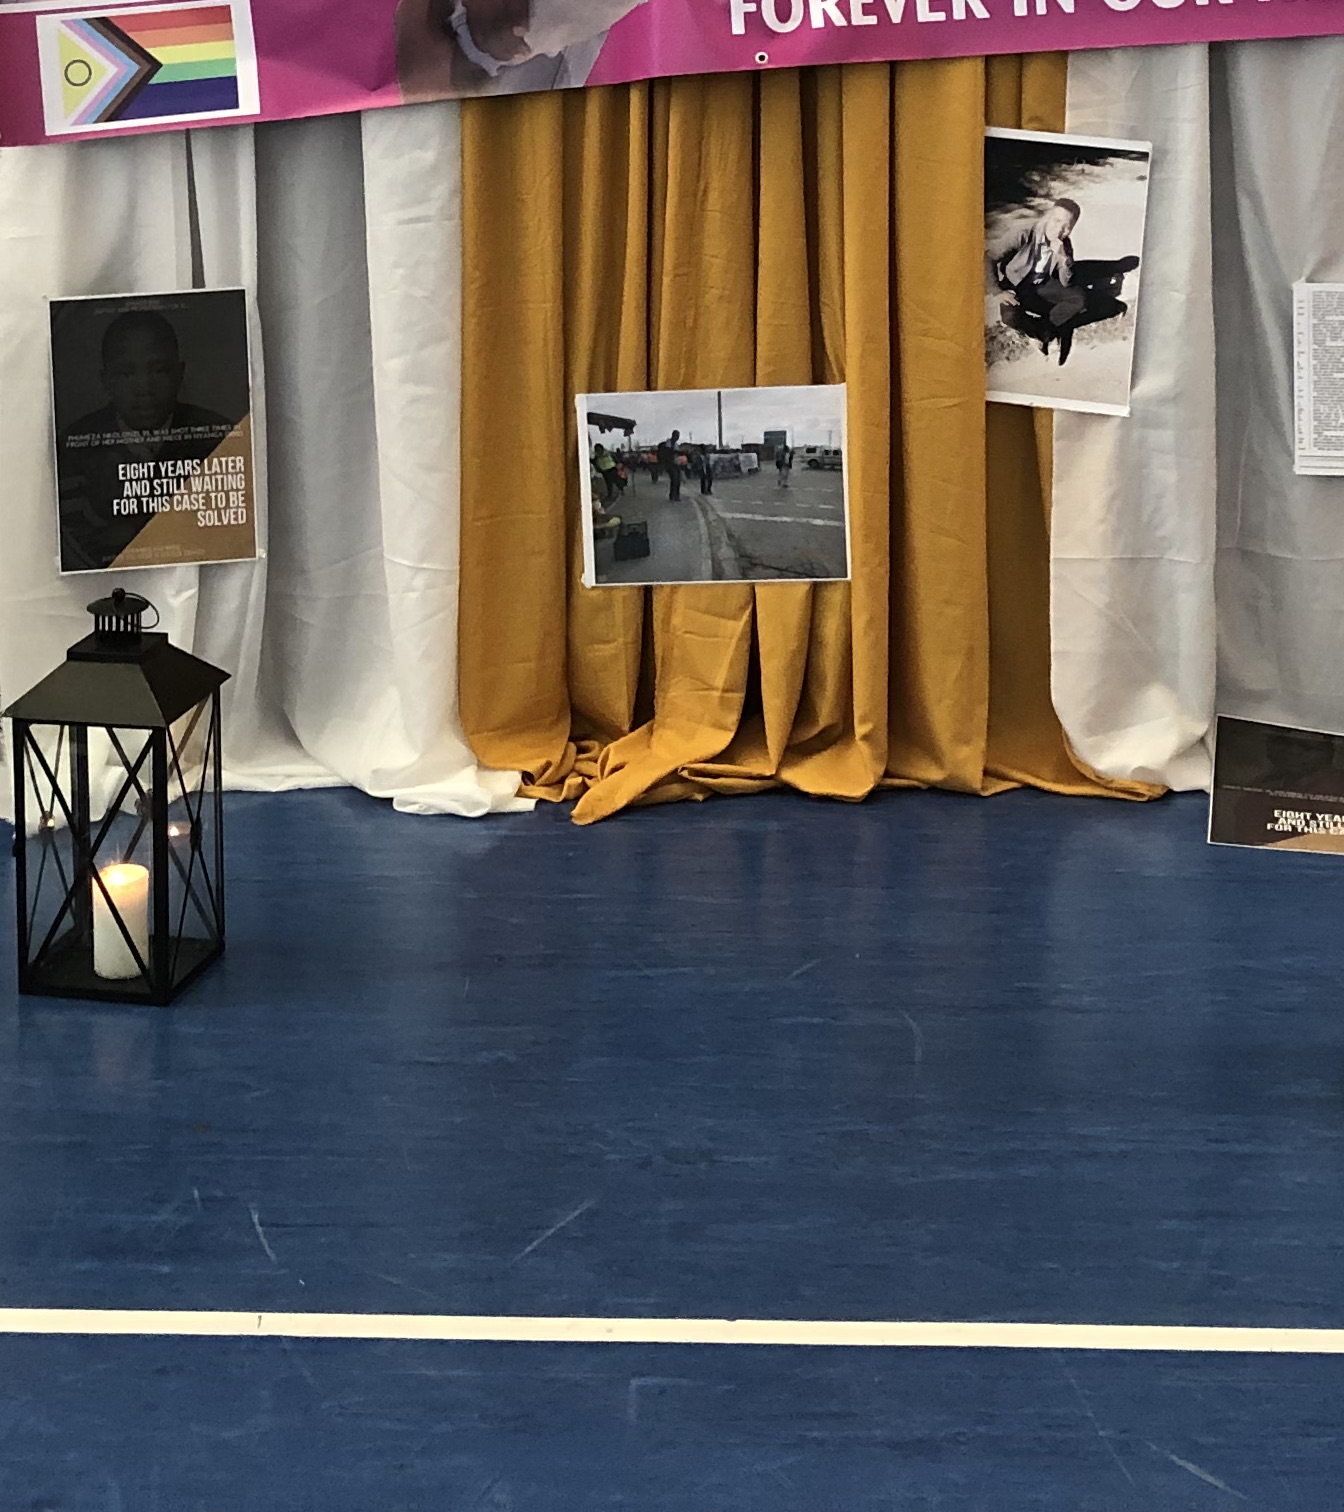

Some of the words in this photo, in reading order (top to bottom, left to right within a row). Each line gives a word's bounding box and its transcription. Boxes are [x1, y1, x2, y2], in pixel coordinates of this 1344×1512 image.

[118, 462, 156, 480] EIGHT
[159, 459, 201, 477] YEARS
[204, 456, 244, 474] LATER
[123, 480, 150, 498] AND
[153, 477, 186, 496] STILL
[190, 473, 246, 493] WAITING
[113, 498, 138, 516] FOR
[141, 495, 170, 514] THIS
[173, 493, 206, 512] CASE
[208, 491, 226, 509] TO
[229, 490, 246, 507] BE
[197, 508, 247, 528] SOLVED
[1274, 809, 1312, 818] EIGHT
[1278, 817, 1306, 827] AND
[1267, 823, 1293, 832] FOR
[1300, 825, 1326, 834] THIS
